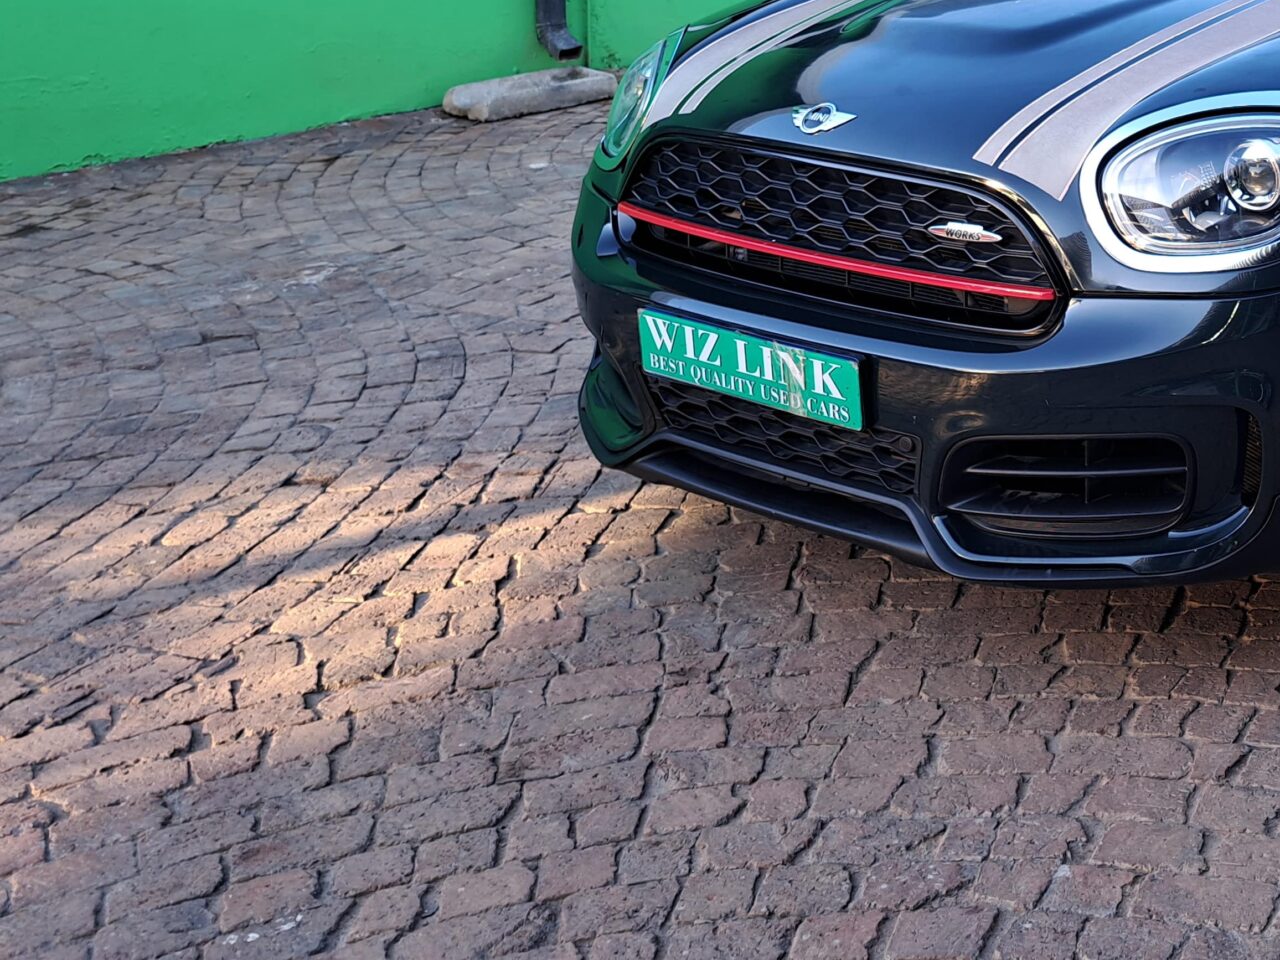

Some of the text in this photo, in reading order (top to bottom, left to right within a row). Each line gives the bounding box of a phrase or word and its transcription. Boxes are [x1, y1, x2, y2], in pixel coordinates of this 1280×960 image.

[945, 227, 982, 241] WORKS
[643, 314, 847, 402] WIZ LINK
[650, 352, 851, 424] BEST QUALITY USED CARS
